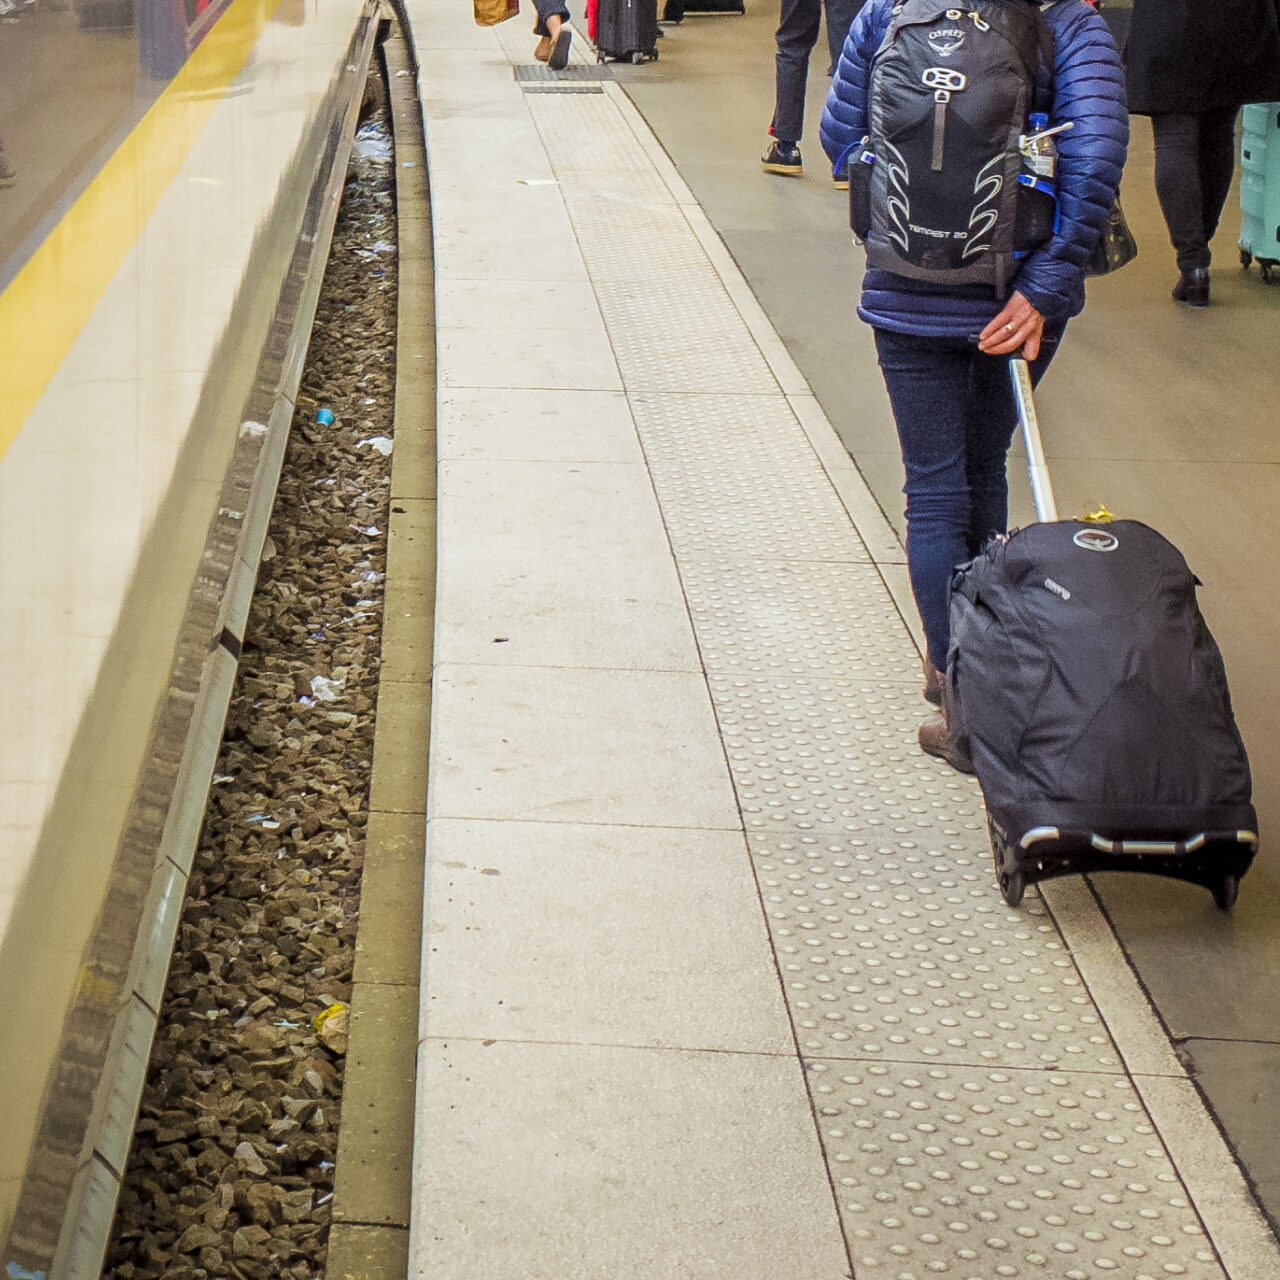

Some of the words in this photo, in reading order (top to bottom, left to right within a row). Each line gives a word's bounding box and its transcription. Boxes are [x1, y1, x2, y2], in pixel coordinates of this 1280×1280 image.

[928, 29, 966, 40] OSPREY
[908, 223, 951, 239] TEMPEST
[953, 231, 968, 239] 20
